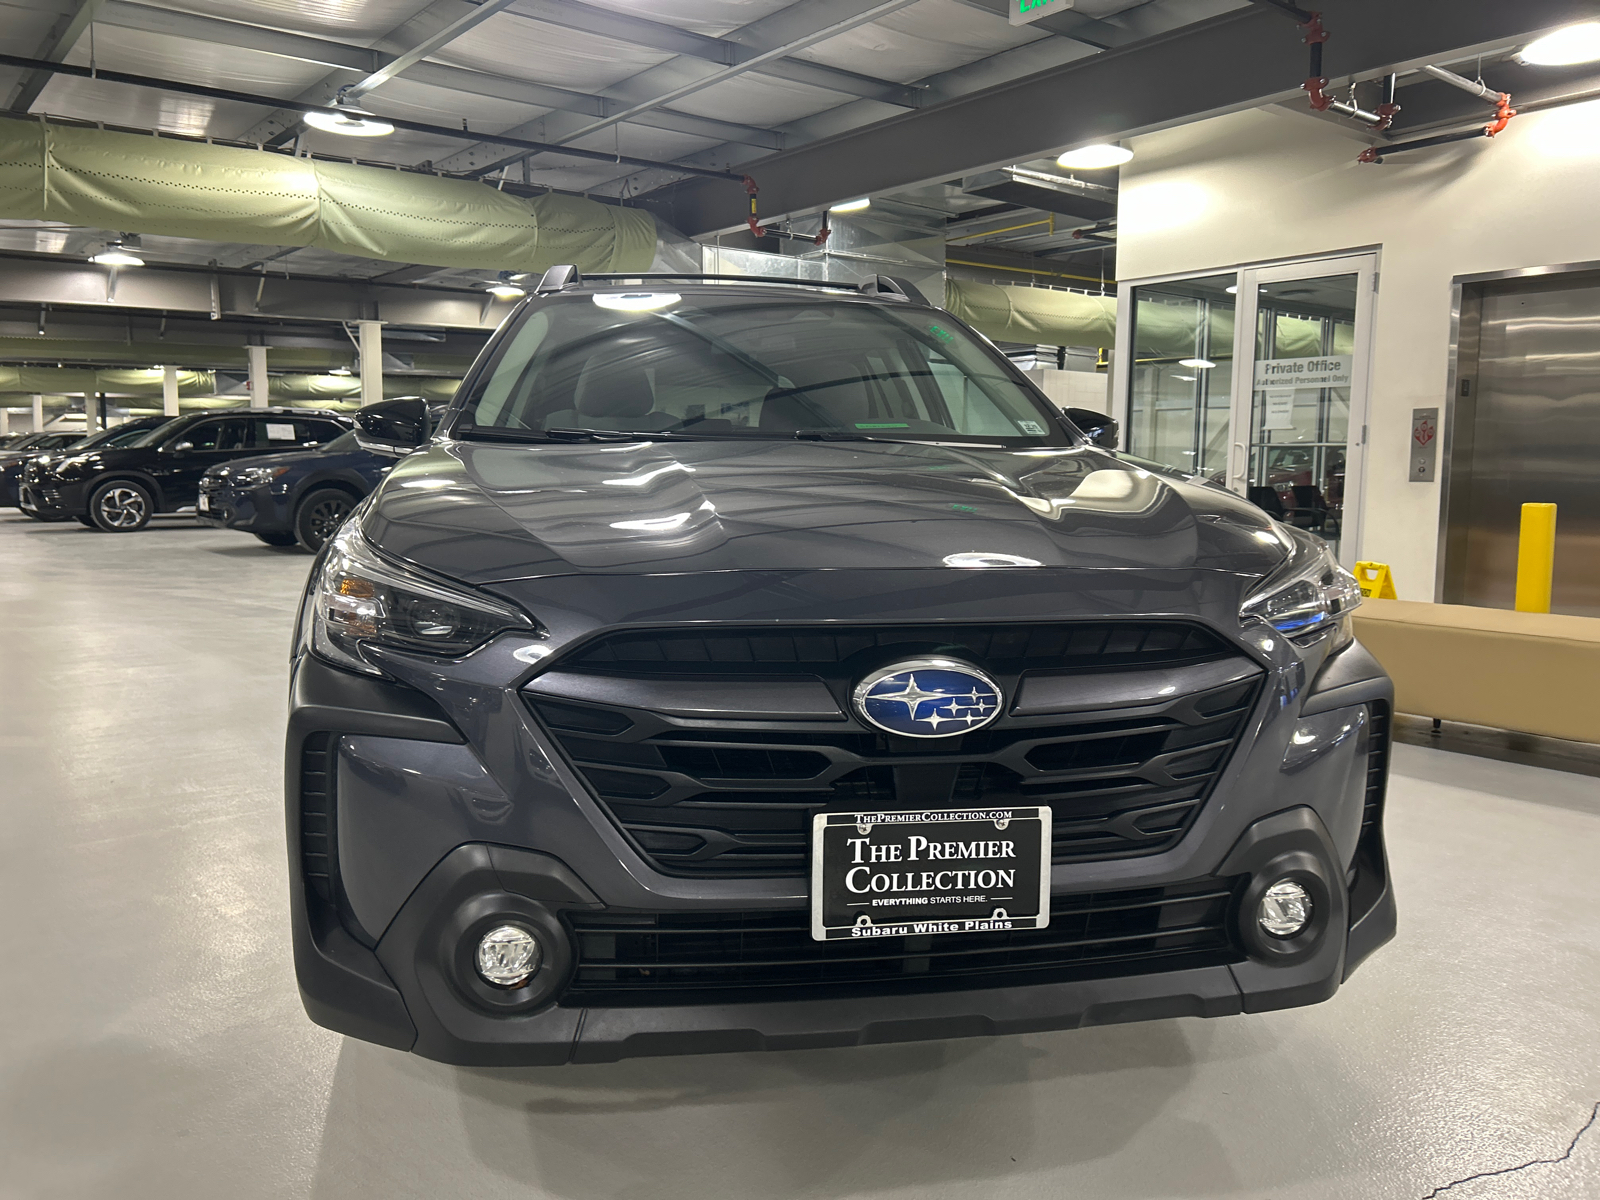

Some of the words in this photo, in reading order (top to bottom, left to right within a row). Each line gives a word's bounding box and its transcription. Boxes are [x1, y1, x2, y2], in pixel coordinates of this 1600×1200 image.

[1265, 362, 1304, 375] Private
[1307, 360, 1341, 372] Office
[1332, 374, 1349, 383] Only
[847, 837, 902, 864] THE
[907, 835, 1017, 861] PREMIER
[845, 865, 1016, 894] COLLECTION
[872, 897, 928, 907] EVERYTHING
[930, 896, 961, 904] STARTS
[963, 895, 988, 903] HERE.
[851, 926, 908, 937] Subaru
[914, 922, 959, 934] White
[965, 919, 1013, 931] Plains
